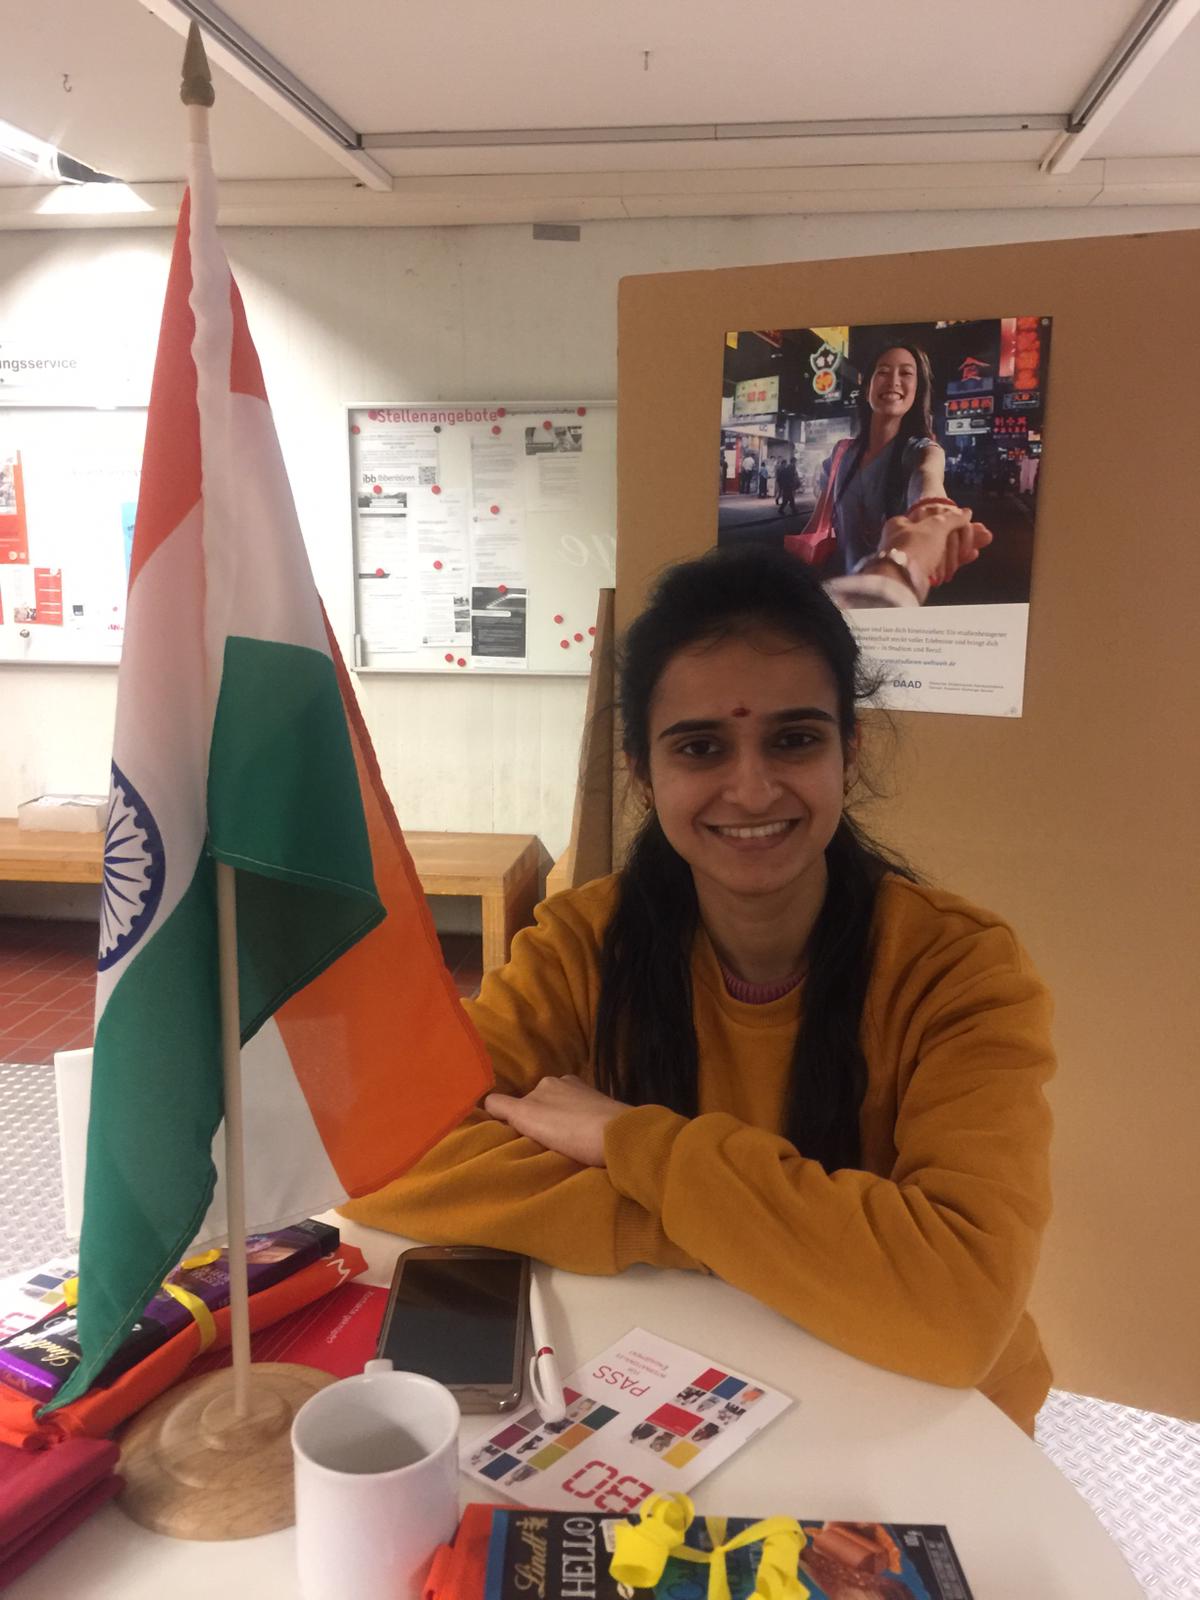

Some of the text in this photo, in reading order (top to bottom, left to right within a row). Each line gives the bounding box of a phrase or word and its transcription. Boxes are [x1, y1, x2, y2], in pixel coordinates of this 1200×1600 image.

[377, 408, 497, 426] Stellenangebote
[893, 679, 922, 689] DAAD
[592, 1364, 651, 1398] PASS
[514, 1530, 548, 1599] Lindt
[561, 1516, 596, 1599] HELLO
